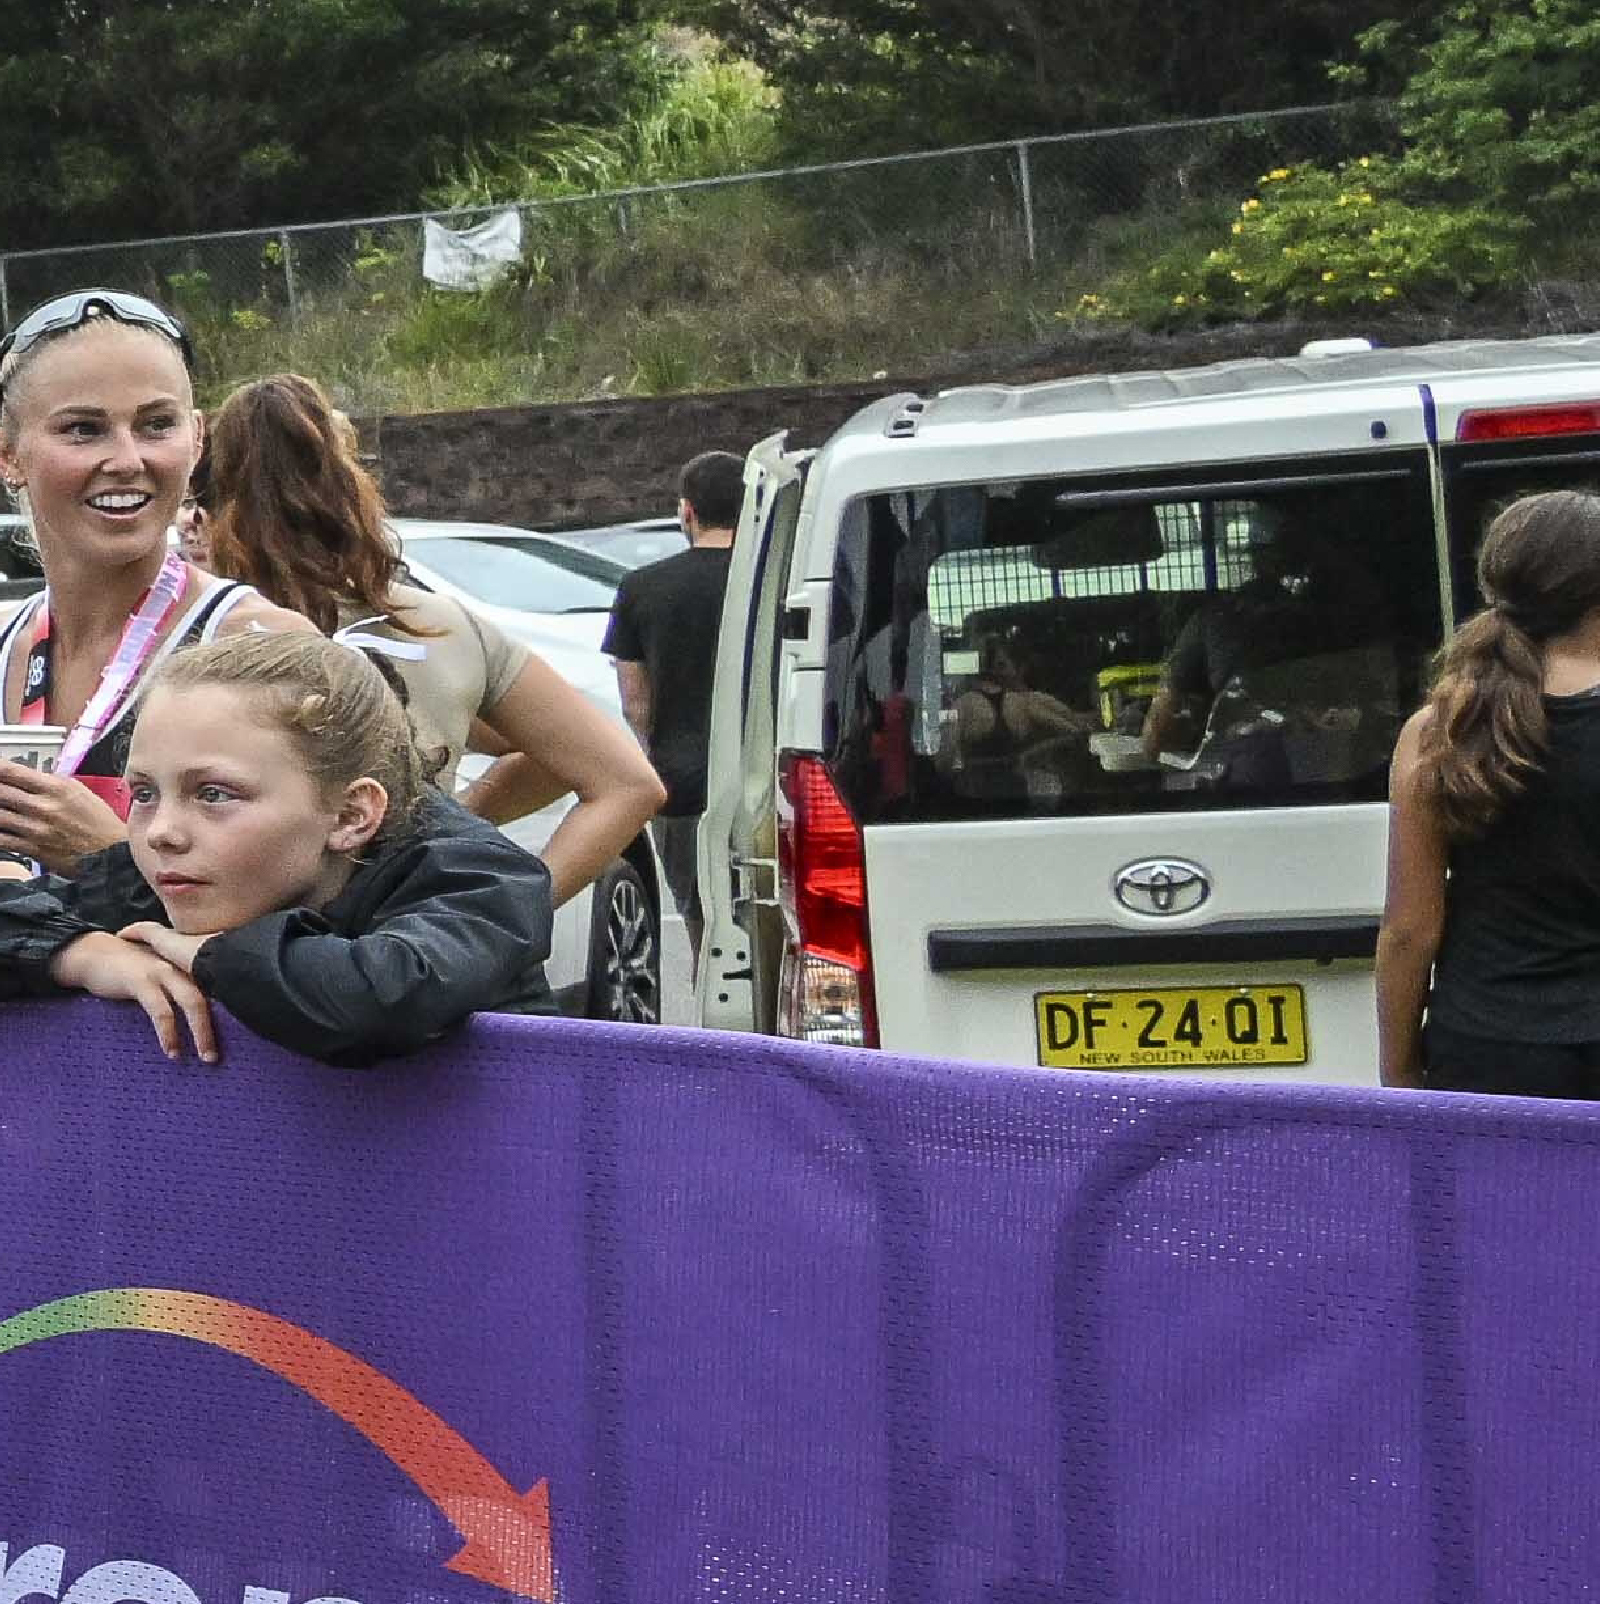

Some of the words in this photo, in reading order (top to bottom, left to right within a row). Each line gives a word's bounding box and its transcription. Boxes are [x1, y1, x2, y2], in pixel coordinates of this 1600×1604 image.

[1079, 1053, 1119, 1066] NEW
[1130, 1050, 1194, 1064] SOUTH
[1204, 1048, 1266, 1063] WALES
